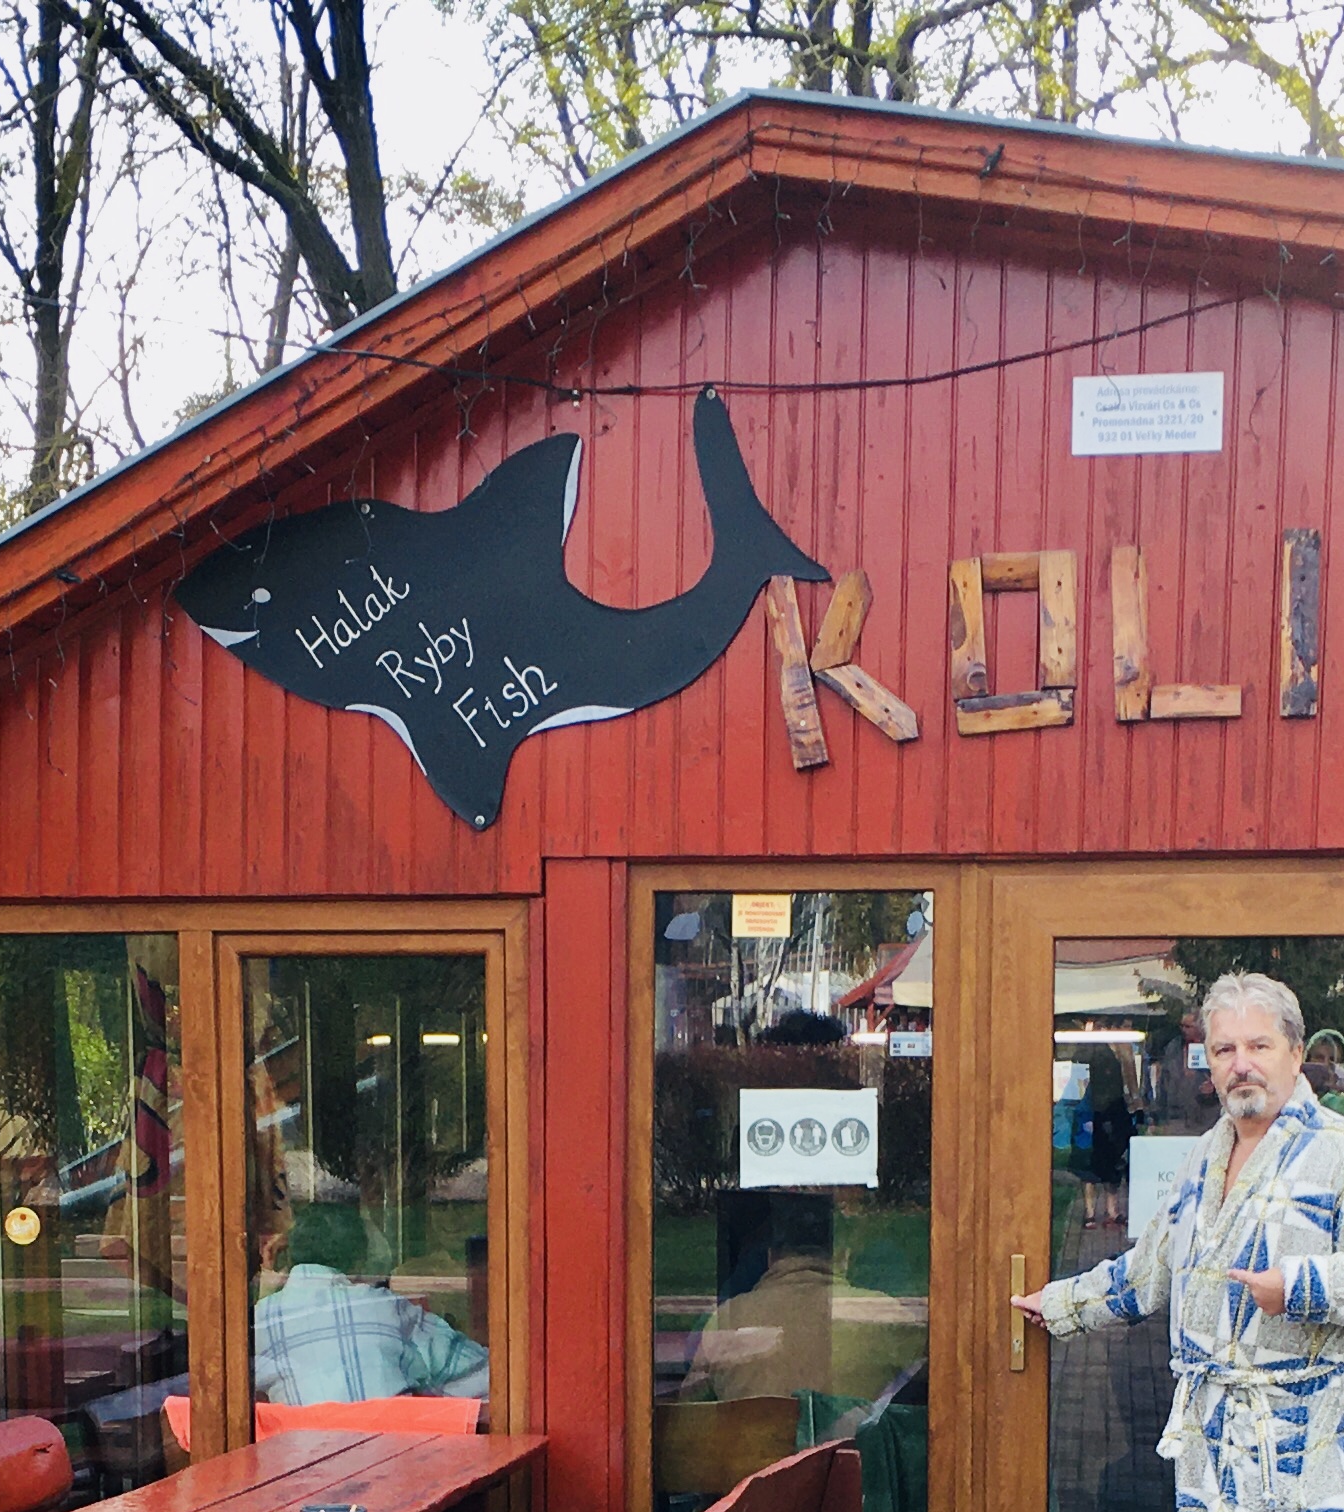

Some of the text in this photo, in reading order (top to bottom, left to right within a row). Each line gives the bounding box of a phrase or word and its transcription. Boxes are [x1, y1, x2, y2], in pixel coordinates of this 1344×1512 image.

[295, 565, 410, 669] Halak
[376, 617, 474, 699] Ryby
[452, 656, 558, 748] Fish
